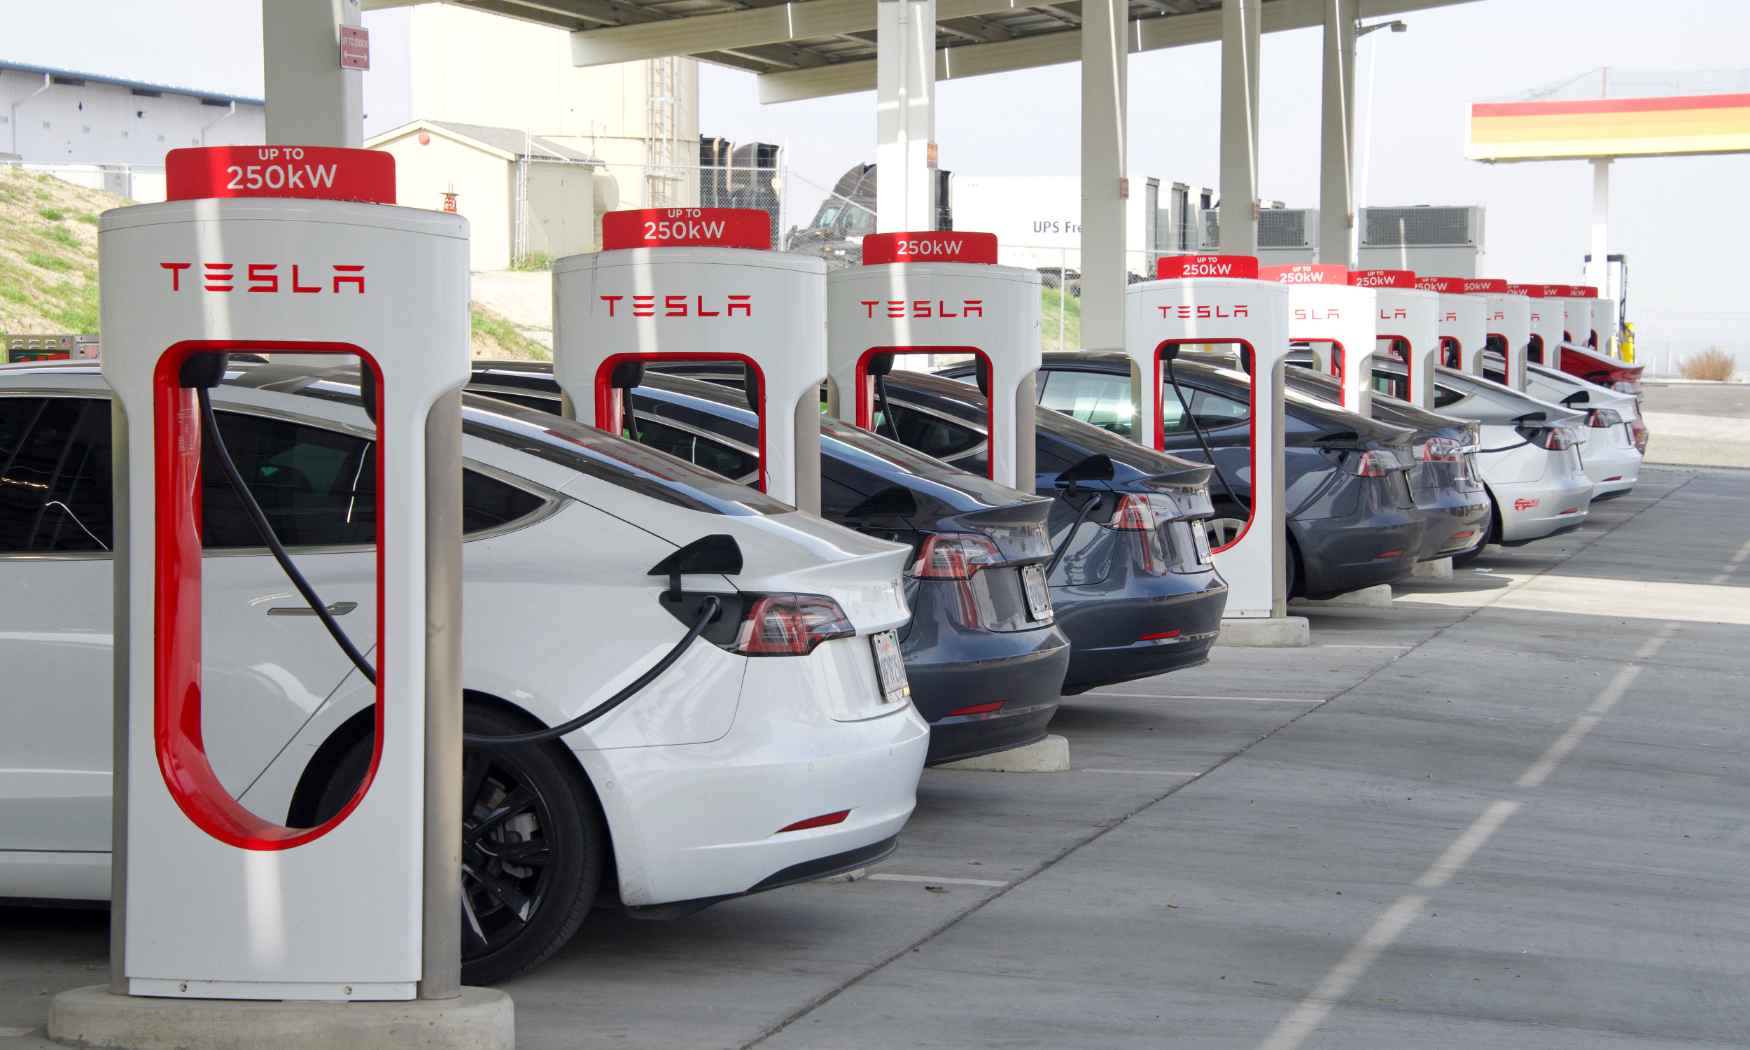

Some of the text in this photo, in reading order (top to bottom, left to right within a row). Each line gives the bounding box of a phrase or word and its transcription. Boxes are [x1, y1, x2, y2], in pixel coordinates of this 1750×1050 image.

[258, 148, 304, 160] UP TO
[226, 163, 337, 190] 250kW
[667, 208, 702, 218] UP TO
[643, 220, 726, 240] 250kW
[1033, 220, 1083, 234] UPS Fre
[896, 239, 963, 256] 250kW
[1182, 263, 1232, 276] 250kW
[160, 262, 365, 294] TESLA
[1280, 271, 1324, 284] 250kW
[1356, 275, 1396, 287] 250kW
[1464, 281, 1492, 291] 50kW
[600, 295, 752, 318] TESLA
[860, 300, 983, 319] TESLA
[1158, 305, 1248, 319] TESLA
[1295, 308, 1340, 320] SLA
